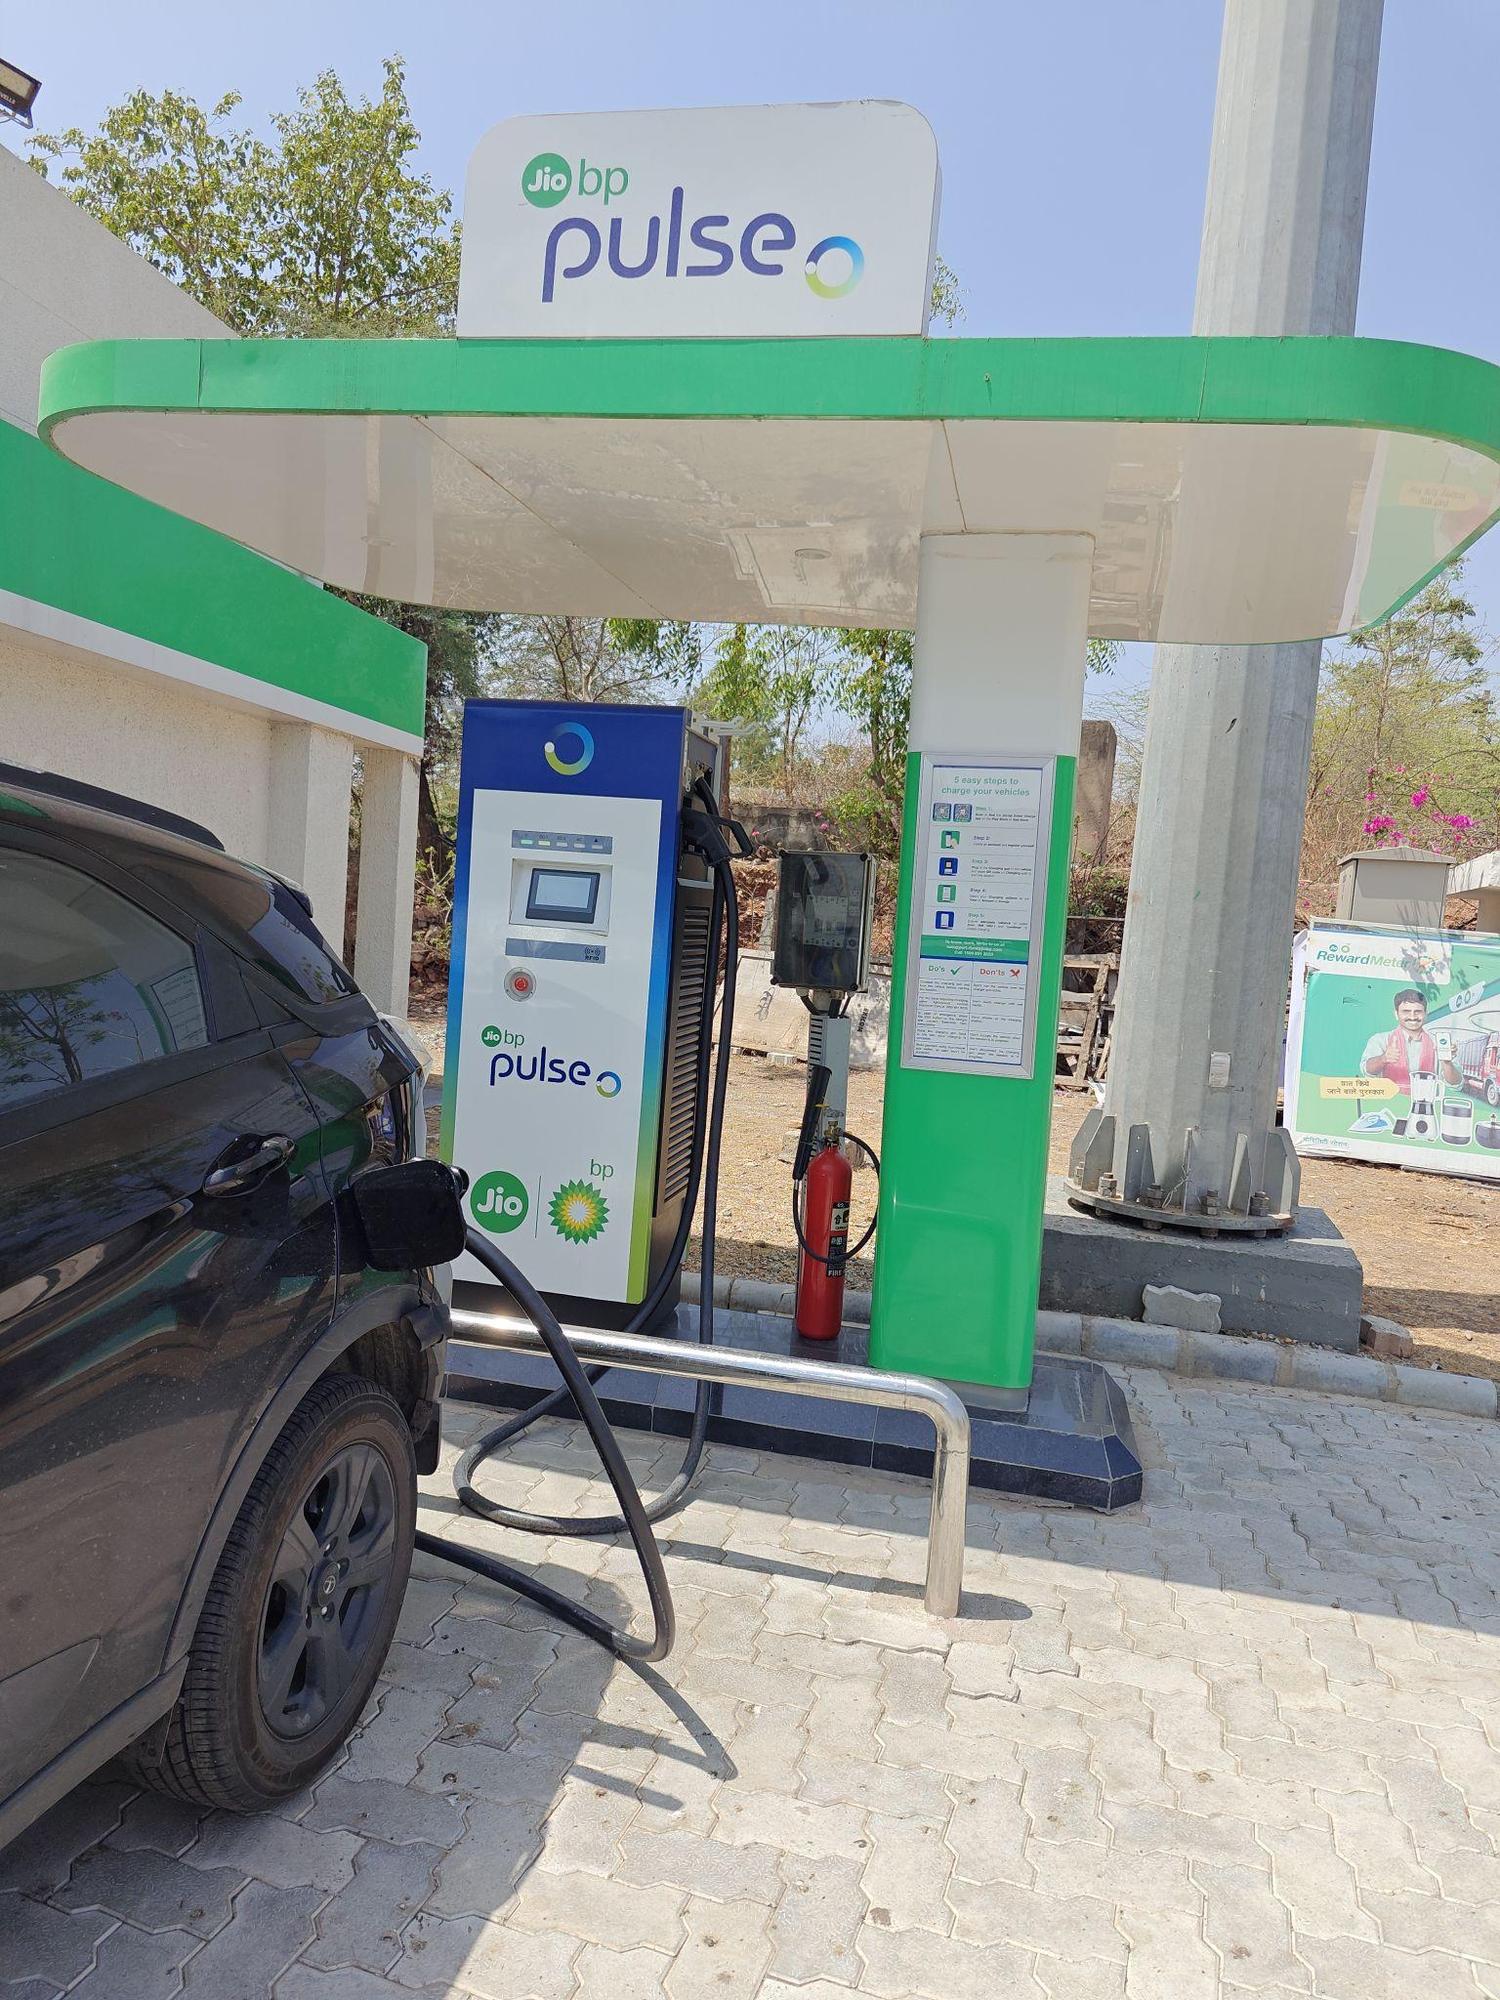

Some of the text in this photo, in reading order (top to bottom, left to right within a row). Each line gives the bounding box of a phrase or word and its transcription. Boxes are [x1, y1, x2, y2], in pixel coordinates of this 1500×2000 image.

[527, 158, 629, 206] Jio bp
[541, 186, 797, 303] pulse
[941, 786, 1030, 797] charge your vehicles
[954, 776, 1019, 786] 5 easy steps to
[928, 965, 946, 973] Do's
[979, 968, 1006, 977] Don'ts
[504, 1029, 525, 1049] bp
[489, 1046, 591, 1087] pulse
[589, 1159, 614, 1181] bp
[477, 1186, 524, 1217] Jio
